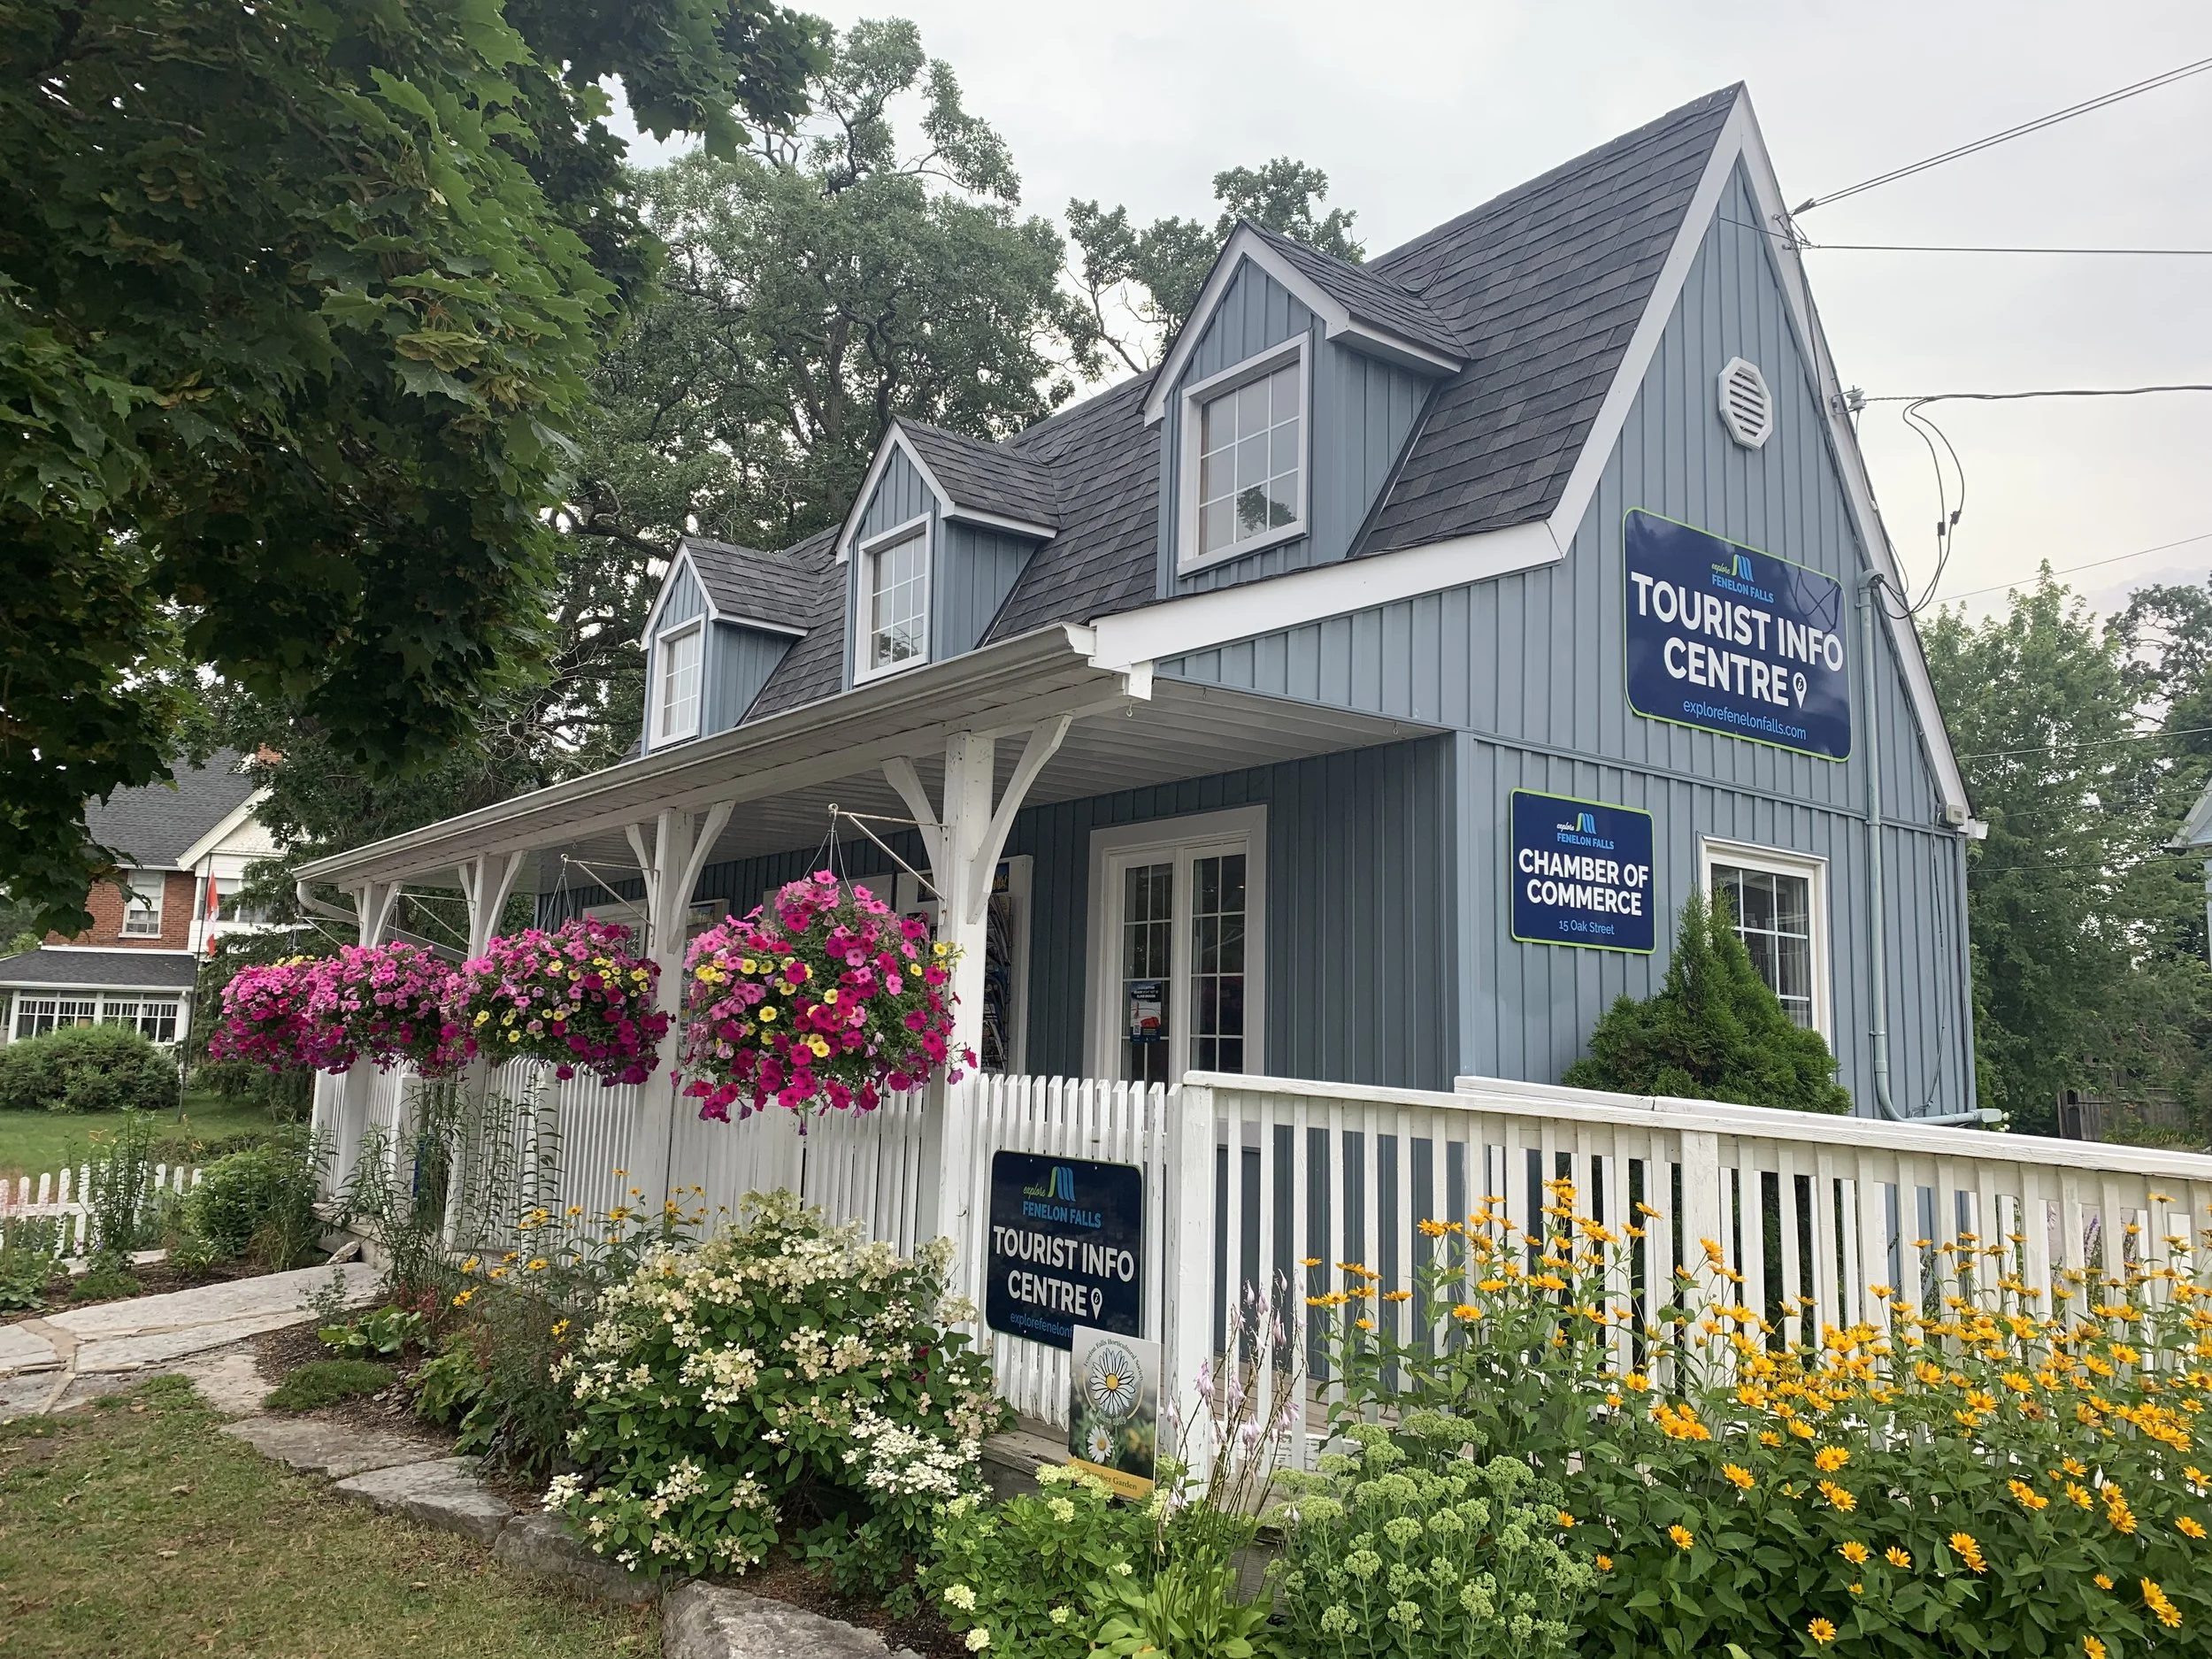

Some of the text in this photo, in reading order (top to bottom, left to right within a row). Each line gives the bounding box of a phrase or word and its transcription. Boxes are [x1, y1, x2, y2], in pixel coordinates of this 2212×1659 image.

[1711, 562, 1731, 575] explore
[1712, 575, 1774, 603] FENELON FALLS
[1631, 571, 1843, 672] TOURIST INFO
[1663, 637, 1789, 706] CENTRE
[1683, 699, 1807, 741] explorefenelonfalls.com
[1557, 833, 1615, 849] FENELON FALLS
[1518, 848, 1649, 888] CHAMBER OF
[1526, 879, 1642, 917] COMMERCE
[1558, 919, 1615, 935] 15 Oak Street
[1023, 1182, 1046, 1200] explore
[1023, 1201, 1102, 1229] FENELON FALLS
[993, 1225, 1134, 1282] TOURIST INFO
[1008, 1270, 1087, 1317] CENTRE
[1095, 1339, 1107, 1348] Falls
[1113, 1477, 1137, 1490] Garden
